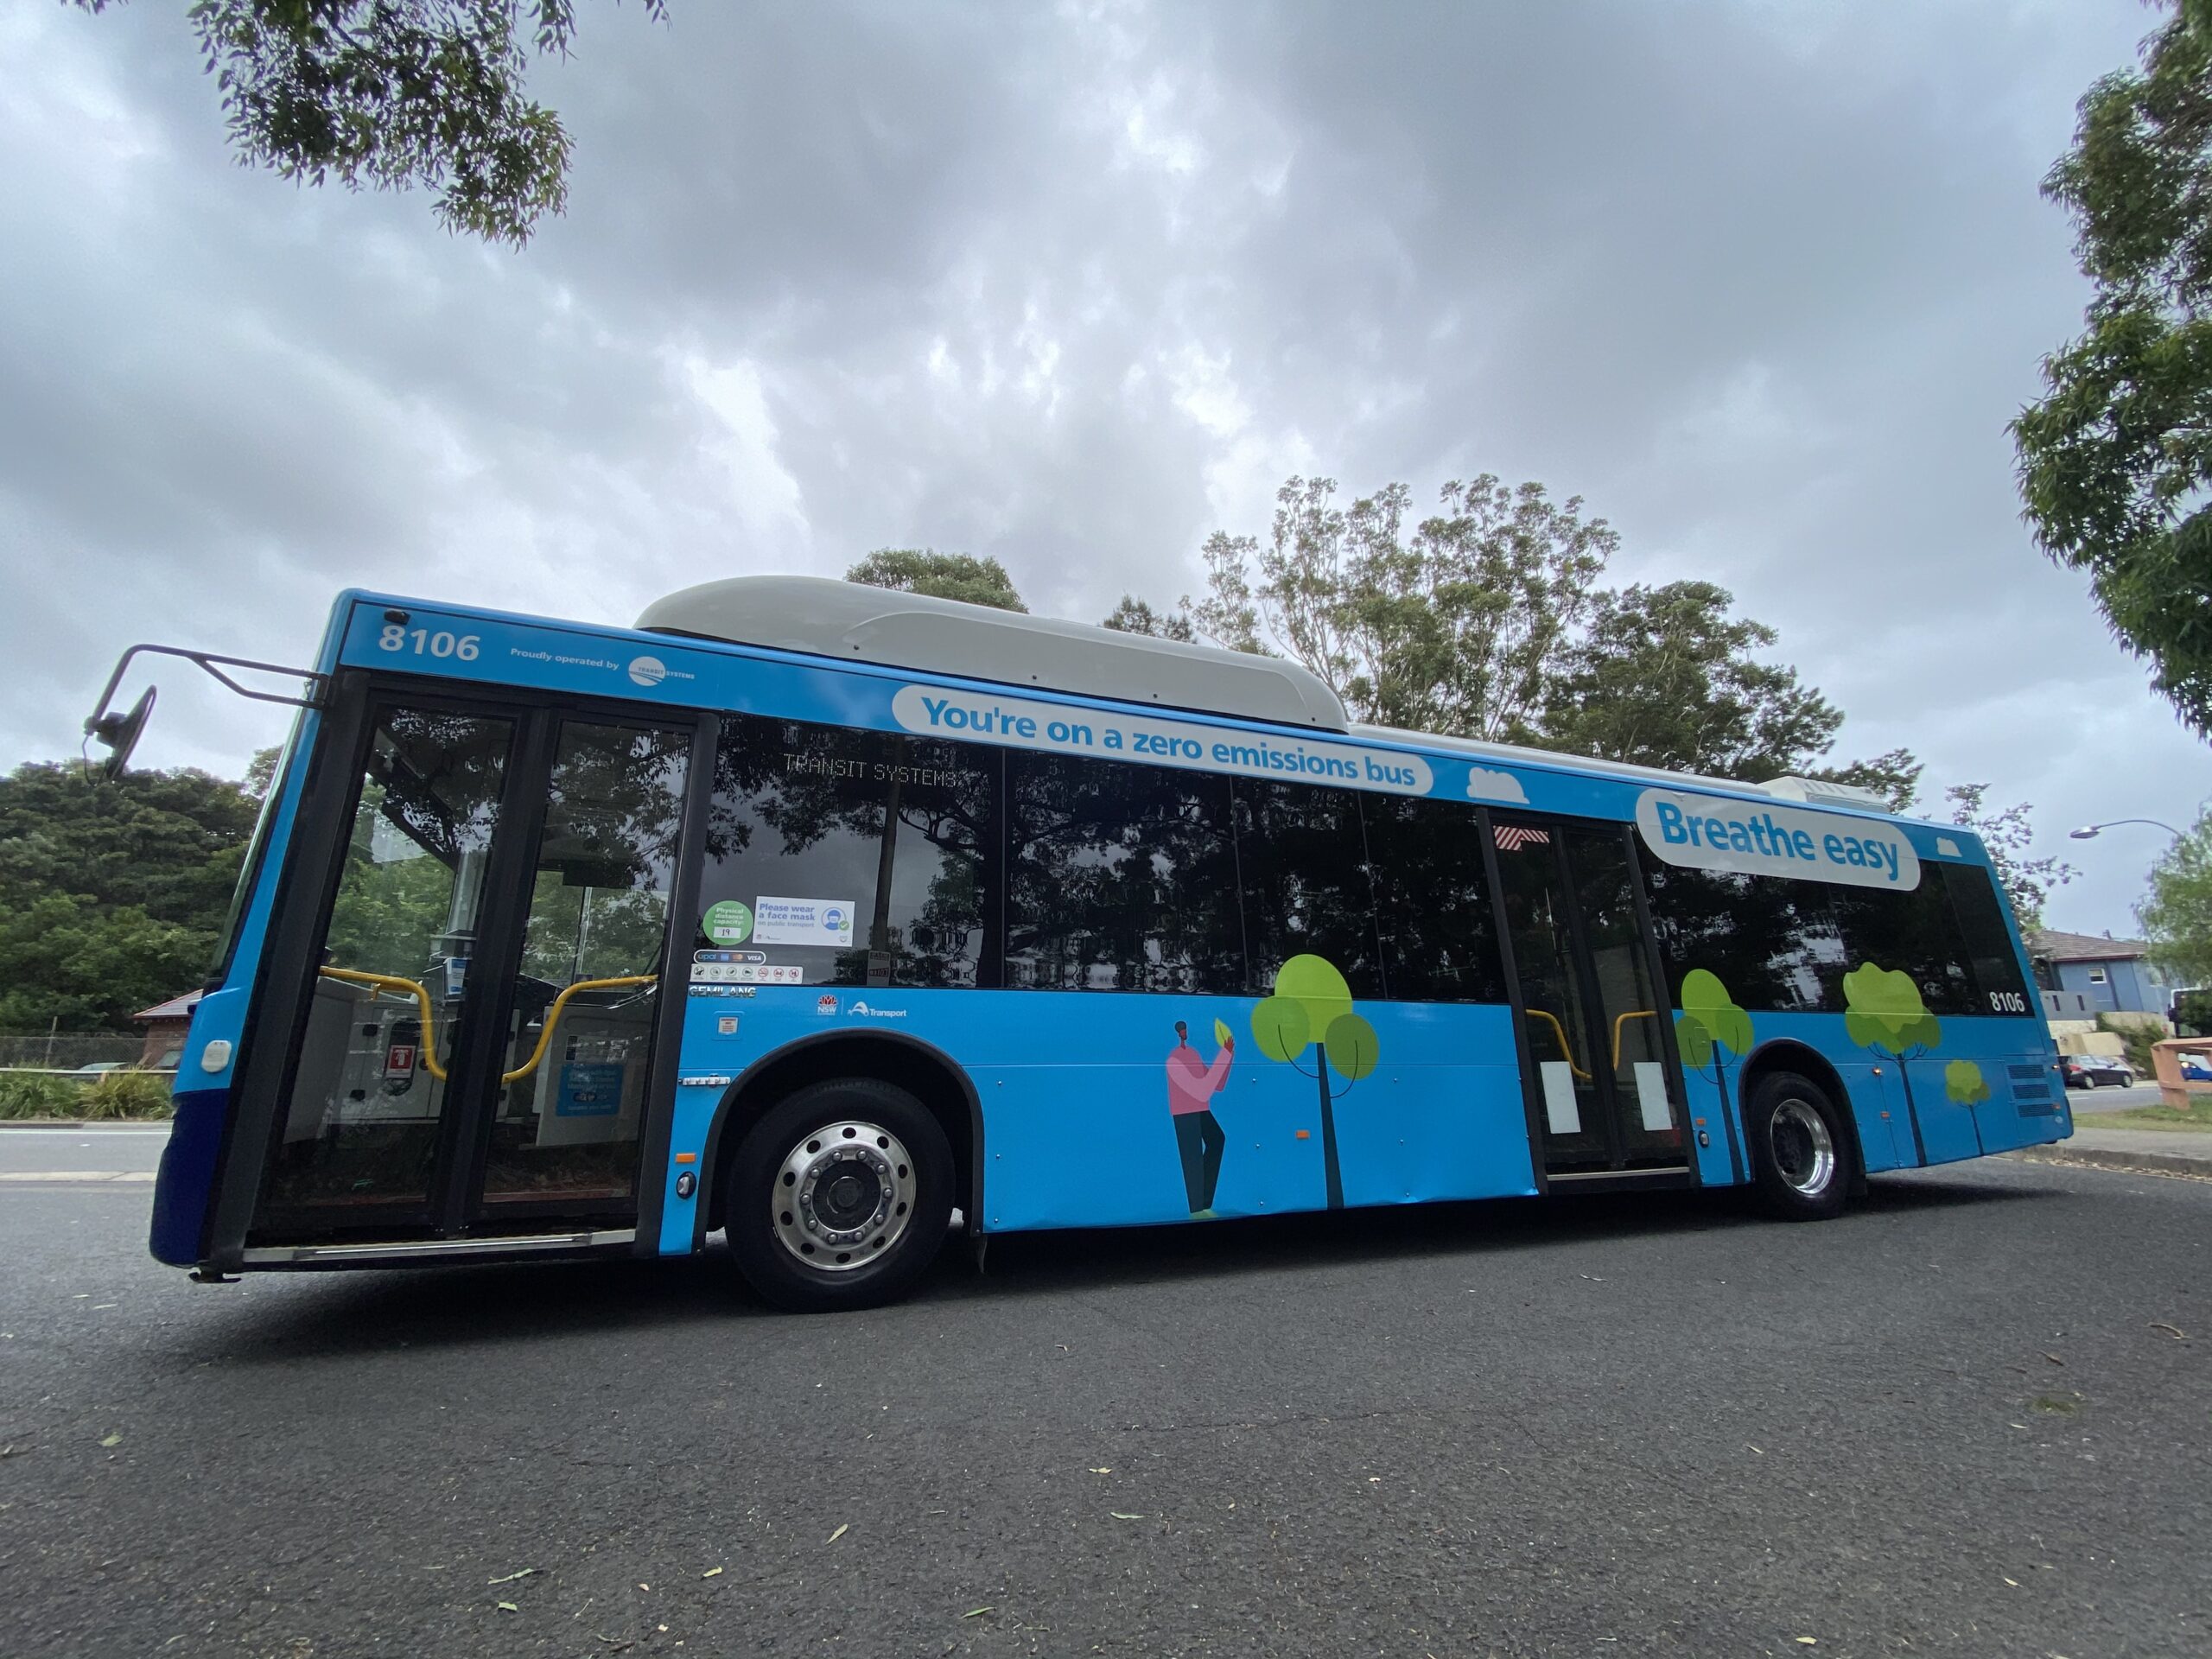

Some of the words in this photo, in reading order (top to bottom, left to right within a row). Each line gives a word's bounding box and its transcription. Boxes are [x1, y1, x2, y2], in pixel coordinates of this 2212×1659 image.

[378, 625, 480, 661] 8106
[511, 648, 553, 662] Proudly
[555, 654, 603, 668] operated
[607, 661, 620, 671] by
[665, 671, 695, 679] SYSTEMS
[920, 696, 1037, 739] You're
[1046, 721, 1092, 745] on
[1103, 728, 1123, 749] a
[1133, 734, 1203, 760] zero
[1212, 741, 1358, 779] emissions
[1366, 763, 1416, 786] bus
[784, 753, 867, 778] TRANSIT
[874, 764, 956, 787] SYSTEMS
[1656, 801, 1815, 861] Breathe
[1823, 834, 1898, 881] easy
[760, 903, 789, 912] Please
[690, 986, 757, 998] GEMILANG
[1989, 991, 2025, 1013] 8106
[869, 1008, 907, 1018] Transport
